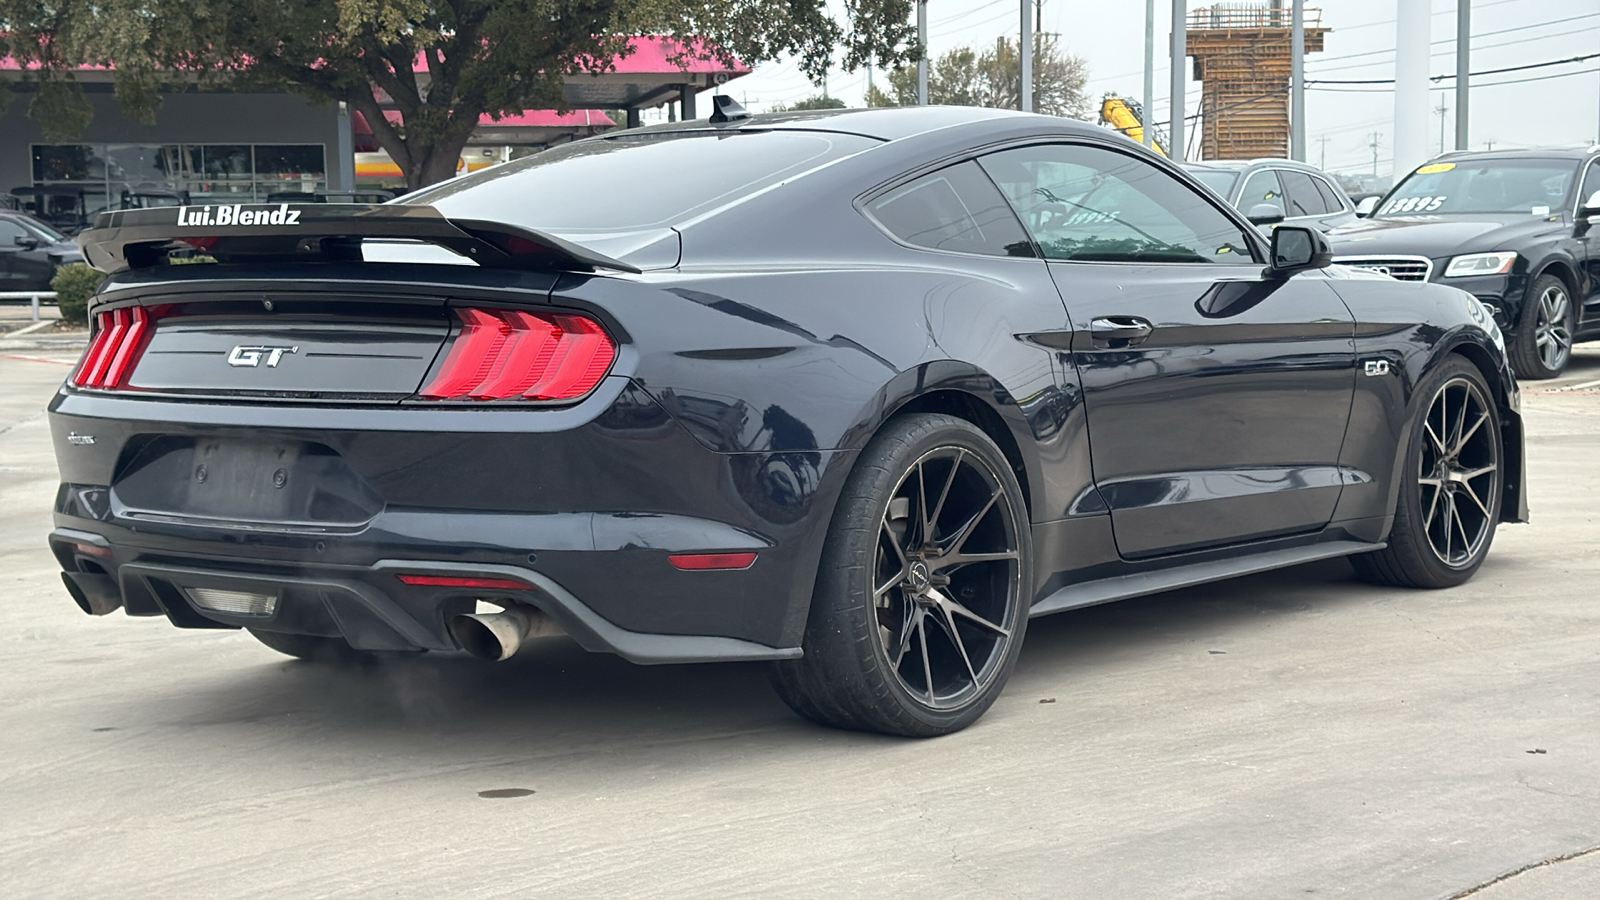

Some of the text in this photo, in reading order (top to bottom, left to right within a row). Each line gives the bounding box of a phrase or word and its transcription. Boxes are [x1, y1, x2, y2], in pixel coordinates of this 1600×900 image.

[177, 204, 301, 226] Lui.Blendz
[1380, 196, 1447, 215] 13895
[227, 345, 298, 368] GT
[1365, 360, 1389, 376] 5.0
